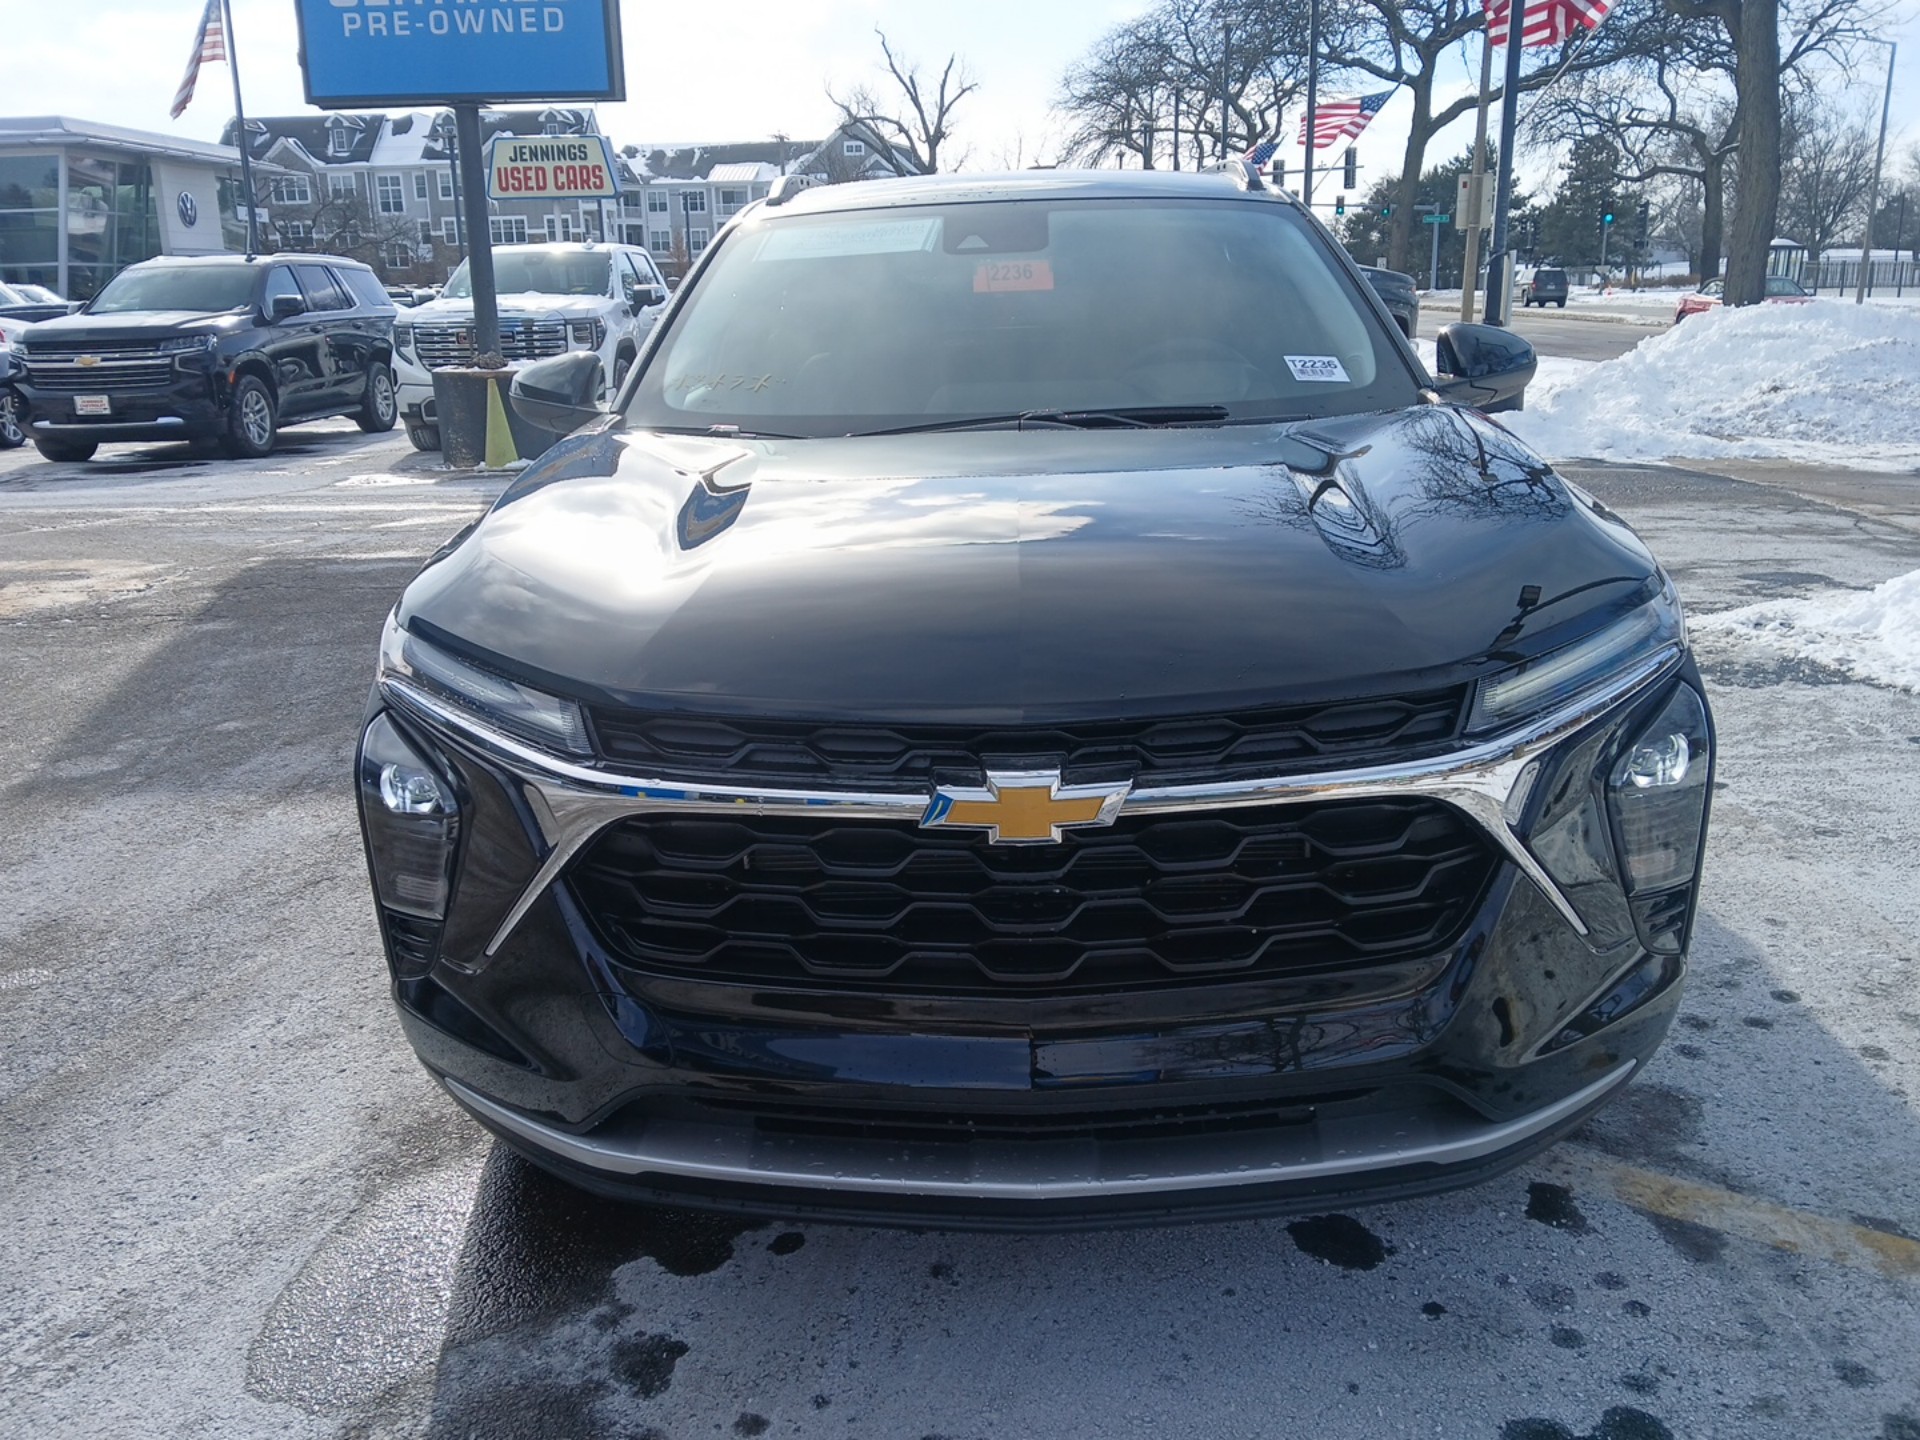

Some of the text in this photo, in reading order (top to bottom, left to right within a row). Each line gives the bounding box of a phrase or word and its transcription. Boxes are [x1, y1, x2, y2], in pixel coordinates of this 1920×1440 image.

[343, 7, 565, 37] PRE-OWNED
[509, 143, 588, 162] JENNINGS
[497, 164, 605, 192] USED CARS
[1288, 359, 1338, 369] T2236
